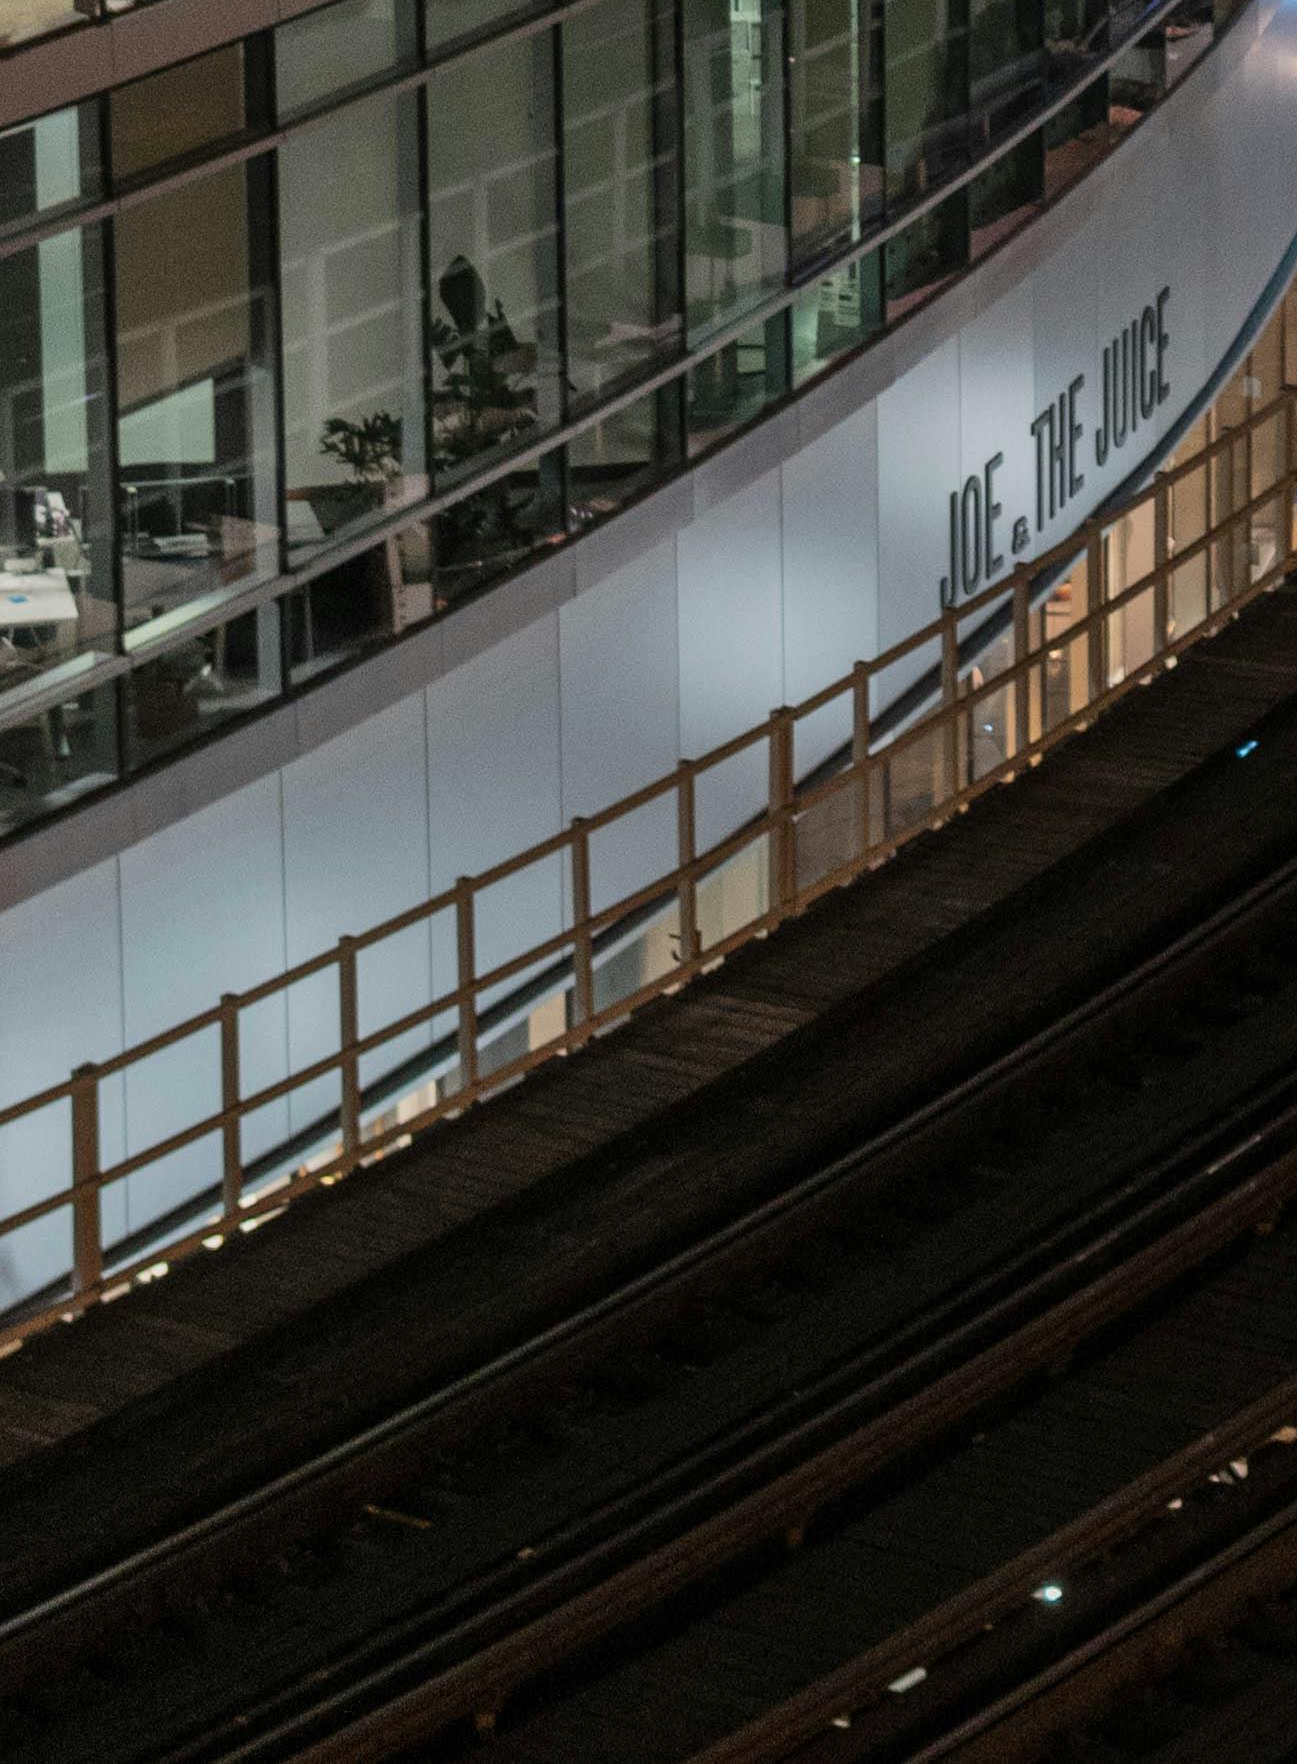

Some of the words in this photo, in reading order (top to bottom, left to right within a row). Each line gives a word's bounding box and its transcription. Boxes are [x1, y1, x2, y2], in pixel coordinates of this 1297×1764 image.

[939, 450, 1005, 609] JOE
[1011, 515, 1032, 555] &
[1030, 373, 1086, 533] THE
[1094, 285, 1172, 468] JUICE
